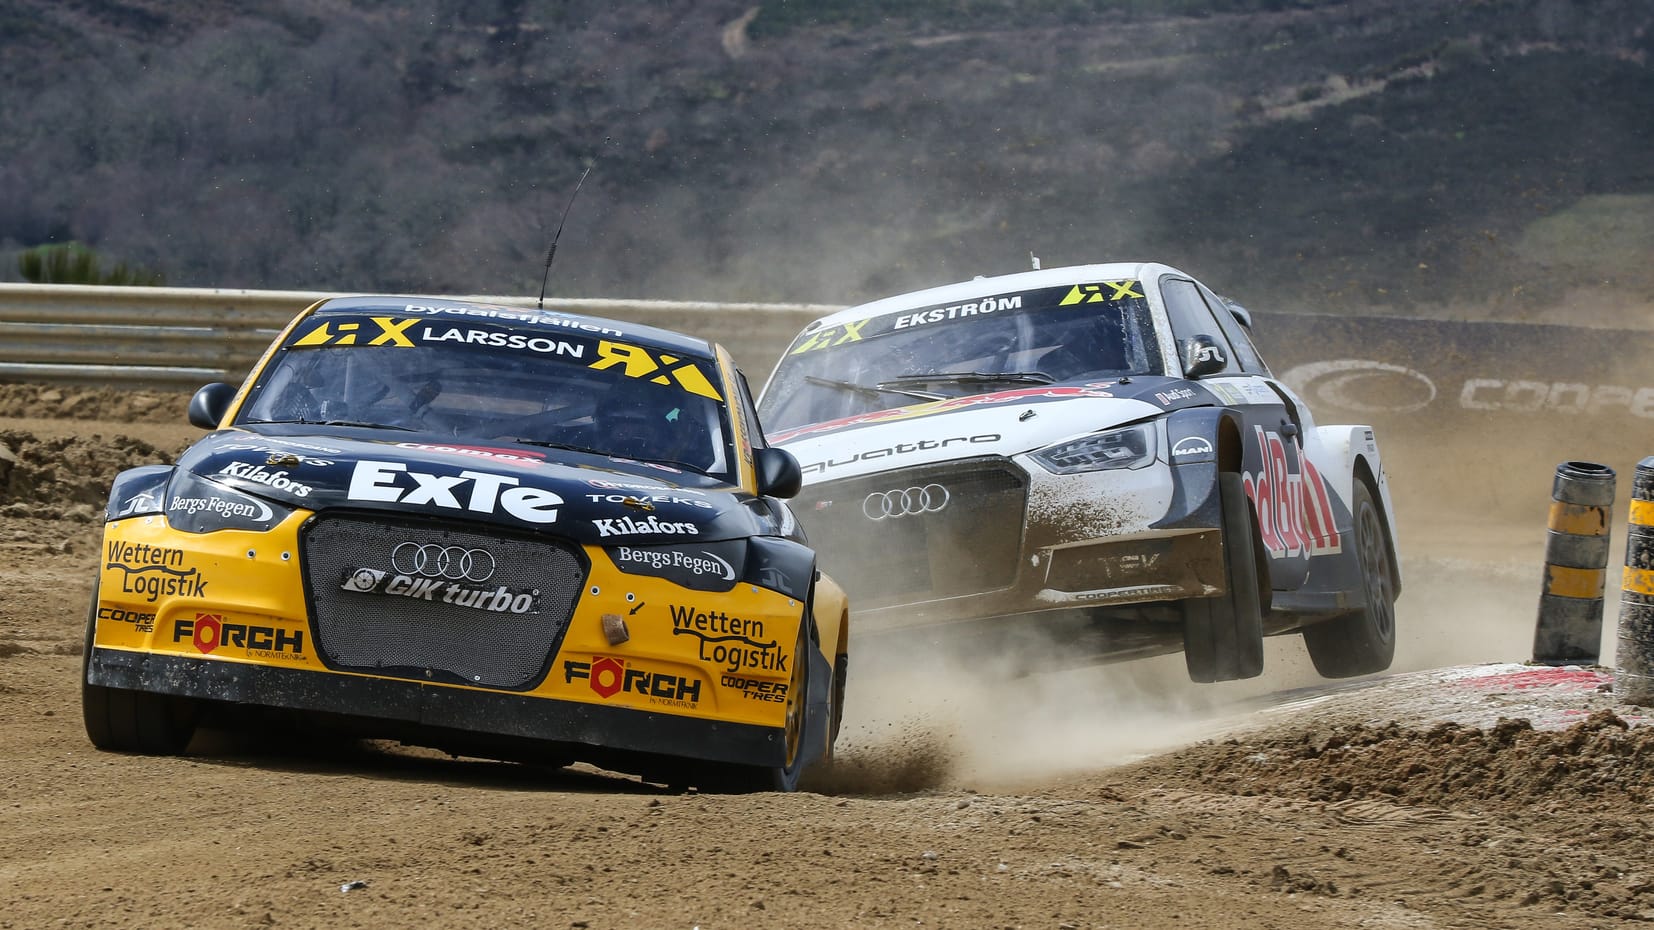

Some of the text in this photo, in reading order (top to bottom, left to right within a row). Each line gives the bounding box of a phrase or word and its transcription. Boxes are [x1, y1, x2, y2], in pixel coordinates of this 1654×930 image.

[894, 295, 1022, 330] EKSTRÖM
[422, 327, 584, 358] LARSSON
[396, 442, 545, 465] cromax
[801, 433, 1001, 474] quattro
[1175, 446, 1209, 456] MAN
[219, 461, 312, 498] Kilafors
[347, 460, 565, 523] ExTe
[169, 496, 255, 517] Bergs Fegen
[592, 515, 699, 538] Kilafors
[108, 541, 184, 566] Wettern
[618, 546, 722, 575] Bergs Fegen
[123, 572, 208, 602] Logistik
[443, 585, 532, 614] turbo
[98, 608, 155, 625] COOPER
[670, 604, 763, 637] Wettern
[700, 642, 788, 672] Logistik
[721, 675, 788, 695] COOPER
